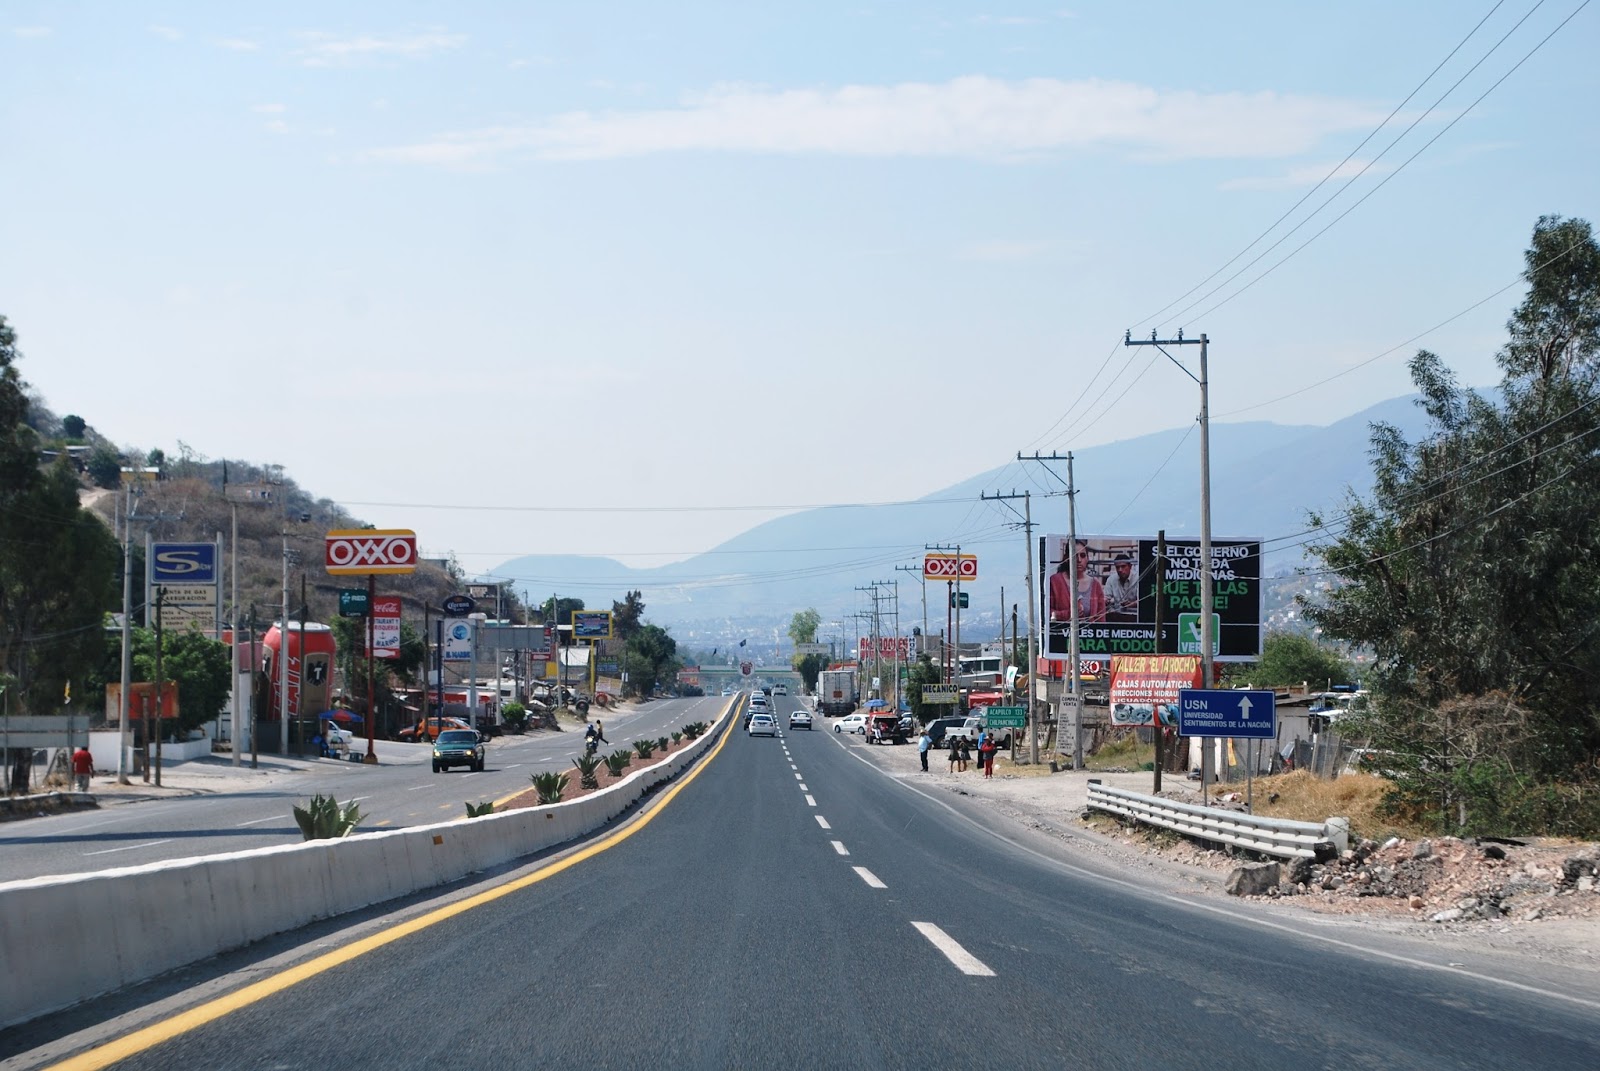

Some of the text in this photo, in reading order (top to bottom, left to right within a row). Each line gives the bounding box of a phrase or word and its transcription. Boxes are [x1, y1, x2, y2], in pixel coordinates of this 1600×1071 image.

[330, 538, 411, 566] OXXO
[1166, 546, 1182, 556] EL
[1184, 546, 1249, 557] GOIERNO
[926, 559, 975, 575] OXXO
[1170, 558, 1190, 569] NO
[1165, 570, 1235, 580] MEDICNAS
[1217, 582, 1248, 595] LAS
[1170, 596, 1228, 609] PAGE!
[1062, 629, 1094, 638] VLES
[1096, 629, 1110, 638] DE
[1181, 642, 1217, 653] VERE
[1113, 656, 1146, 673] TALLER
[922, 685, 958, 693] MECANICO
[1116, 680, 1193, 689] CAJAS AUTOMATICAS
[1184, 700, 1208, 710] USN
[1183, 712, 1224, 720] UNIVERSIDAD
[1183, 720, 1227, 728] SENTIMIENTOS
[1247, 721, 1271, 729] NACIÓN
